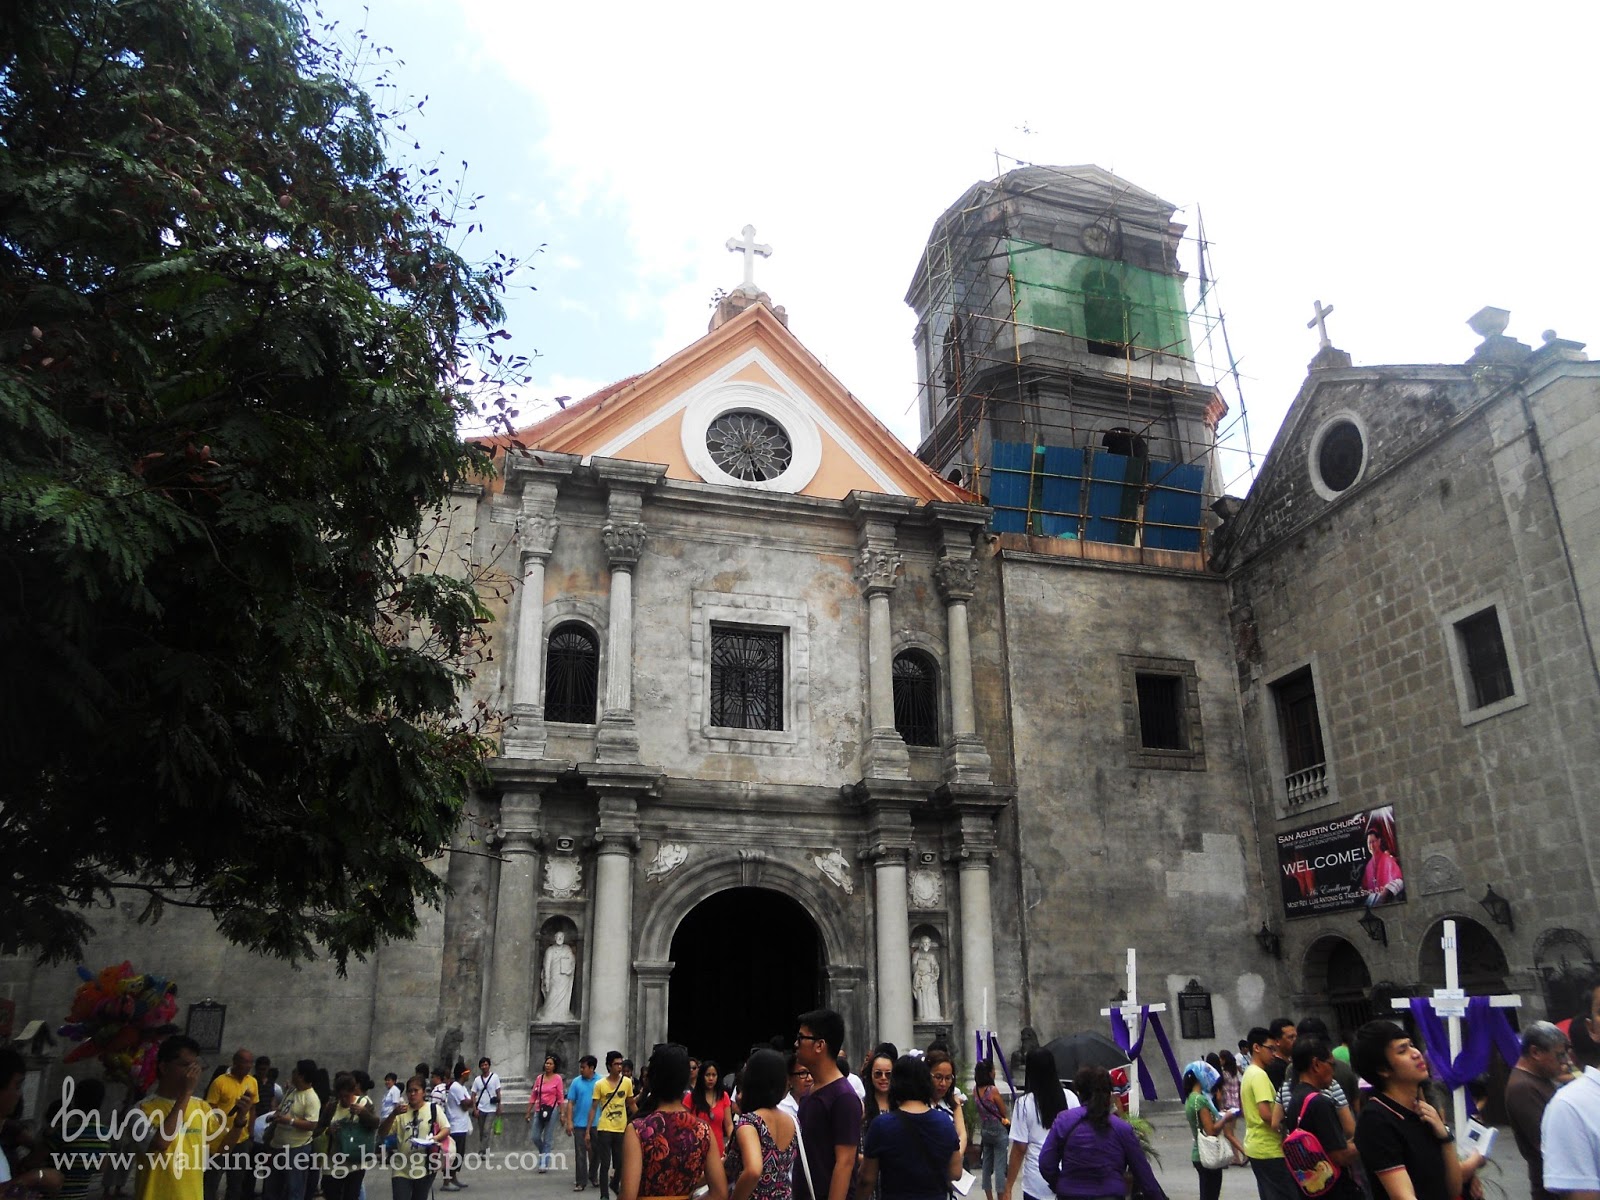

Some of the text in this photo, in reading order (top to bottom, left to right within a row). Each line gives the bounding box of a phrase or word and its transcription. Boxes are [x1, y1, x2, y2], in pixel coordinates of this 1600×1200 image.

[1278, 816, 1366, 844] SAN AGUSTIN CHURCH
[1282, 847, 1366, 875] WELCOME!
